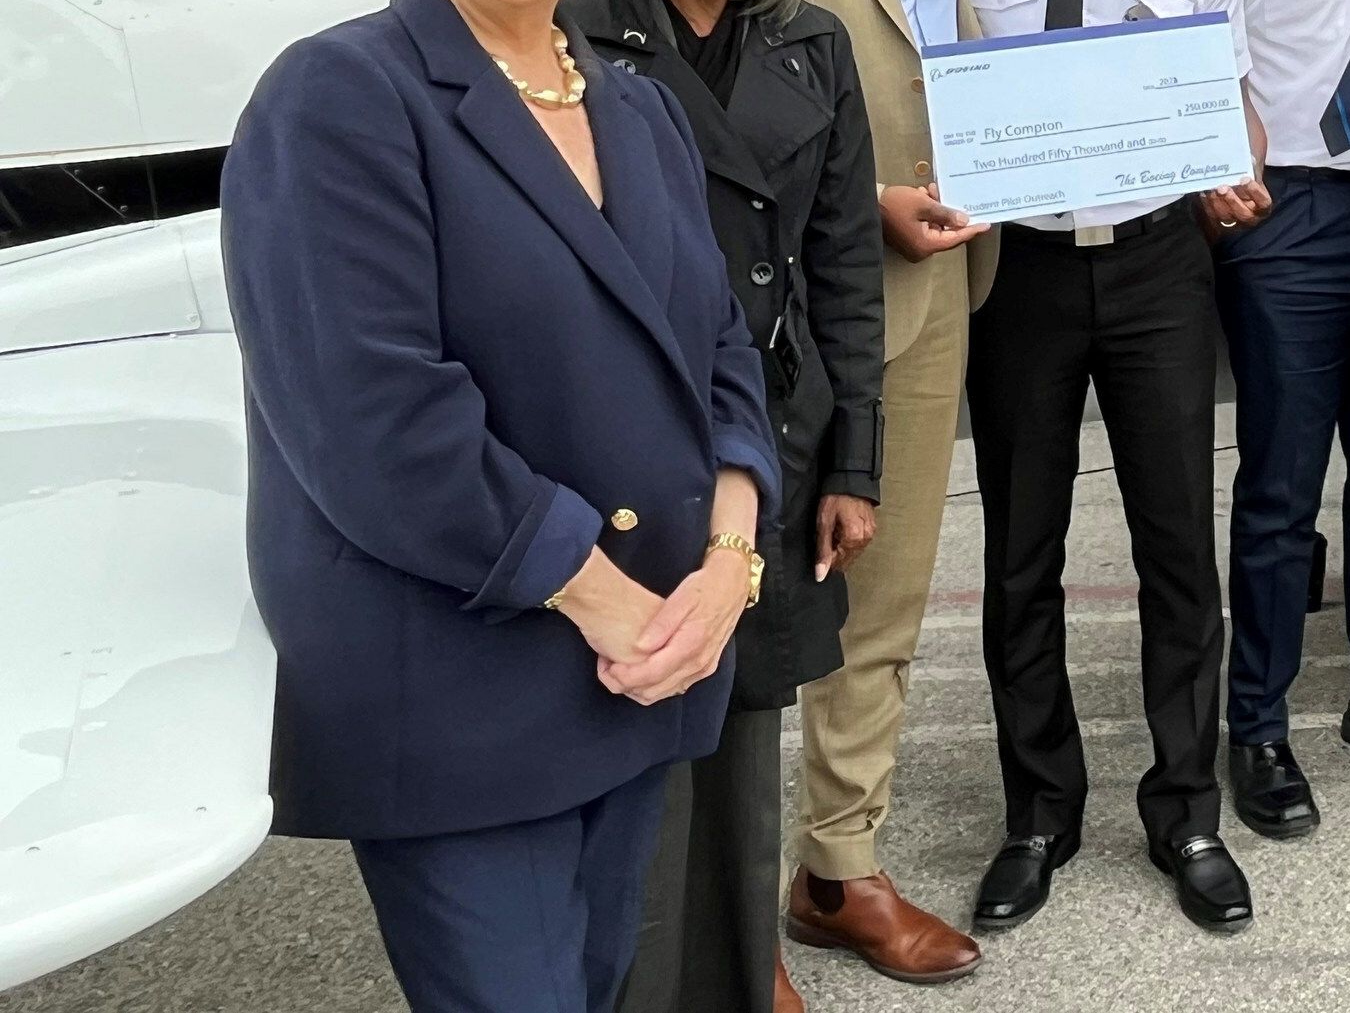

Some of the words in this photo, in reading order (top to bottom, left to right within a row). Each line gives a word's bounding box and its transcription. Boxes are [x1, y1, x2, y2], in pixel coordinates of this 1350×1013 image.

[984, 127, 1002, 141] Fly
[1005, 121, 1063, 139] Compton
[973, 159, 996, 170] Two
[1000, 151, 1045, 166] Hundred
[1048, 146, 1072, 160] Fifty
[1073, 140, 1123, 155] Thousand
[1126, 137, 1147, 148] and
[1114, 172, 1136, 187] The
[1181, 164, 1229, 179] Company
[964, 201, 999, 211] Student
[1024, 190, 1065, 202] Outreach
